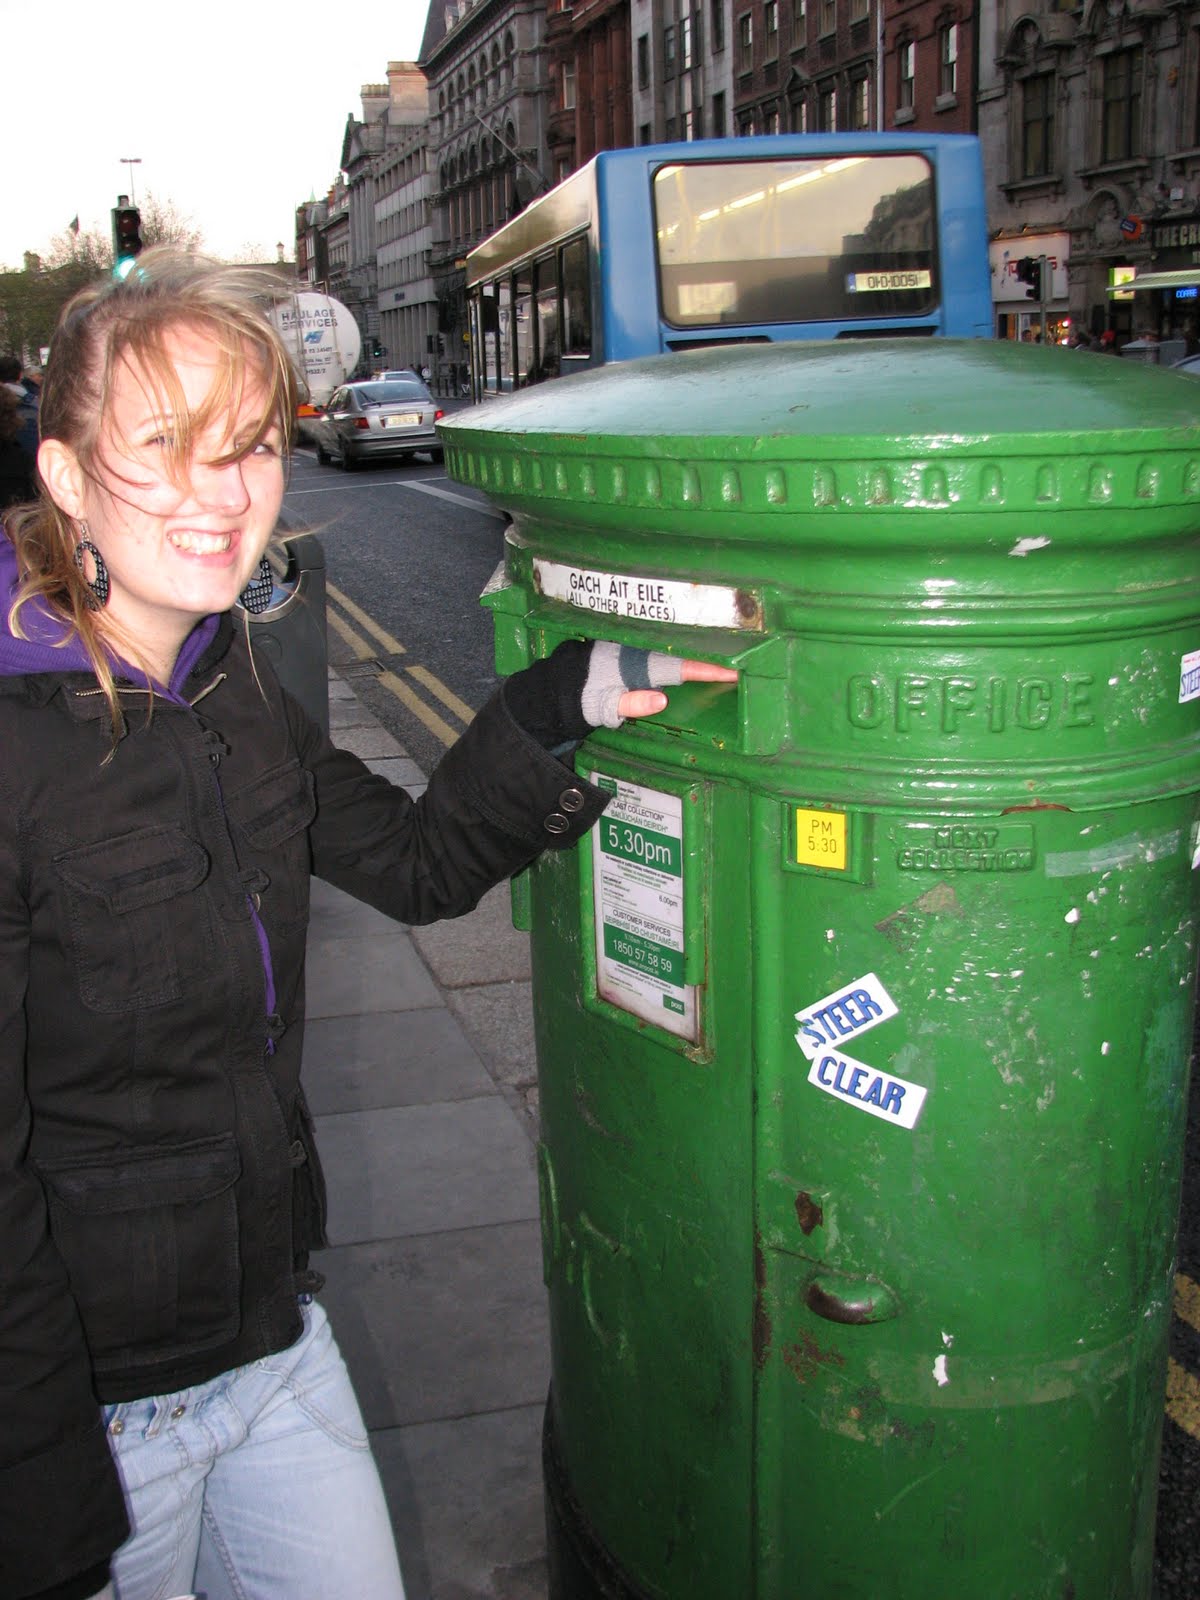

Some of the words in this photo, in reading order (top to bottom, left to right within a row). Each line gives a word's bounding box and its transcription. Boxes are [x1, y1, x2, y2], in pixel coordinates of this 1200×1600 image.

[281, 308, 336, 321] HAULAGE
[282, 318, 338, 331] SERVICES
[569, 572, 601, 595] GACH
[609, 576, 628, 600] ÁIT
[588, 596, 619, 614] OTHER
[846, 672, 1097, 734] OFFICE
[811, 819, 833, 836] PM
[934, 826, 999, 849] NEXT
[608, 824, 672, 866] 5.30pm
[808, 836, 837, 854] 5:30
[897, 848, 1034, 871] COLLECTION
[613, 909, 643, 926] CUSTOMER
[643, 920, 671, 937] SERVICES
[613, 939, 633, 957] 1850
[635, 948, 645, 961] 57
[647, 953, 659, 967] 58
[660, 957, 672, 973] 59
[802, 988, 883, 1048] STEER
[817, 1056, 906, 1115] CLEAR
